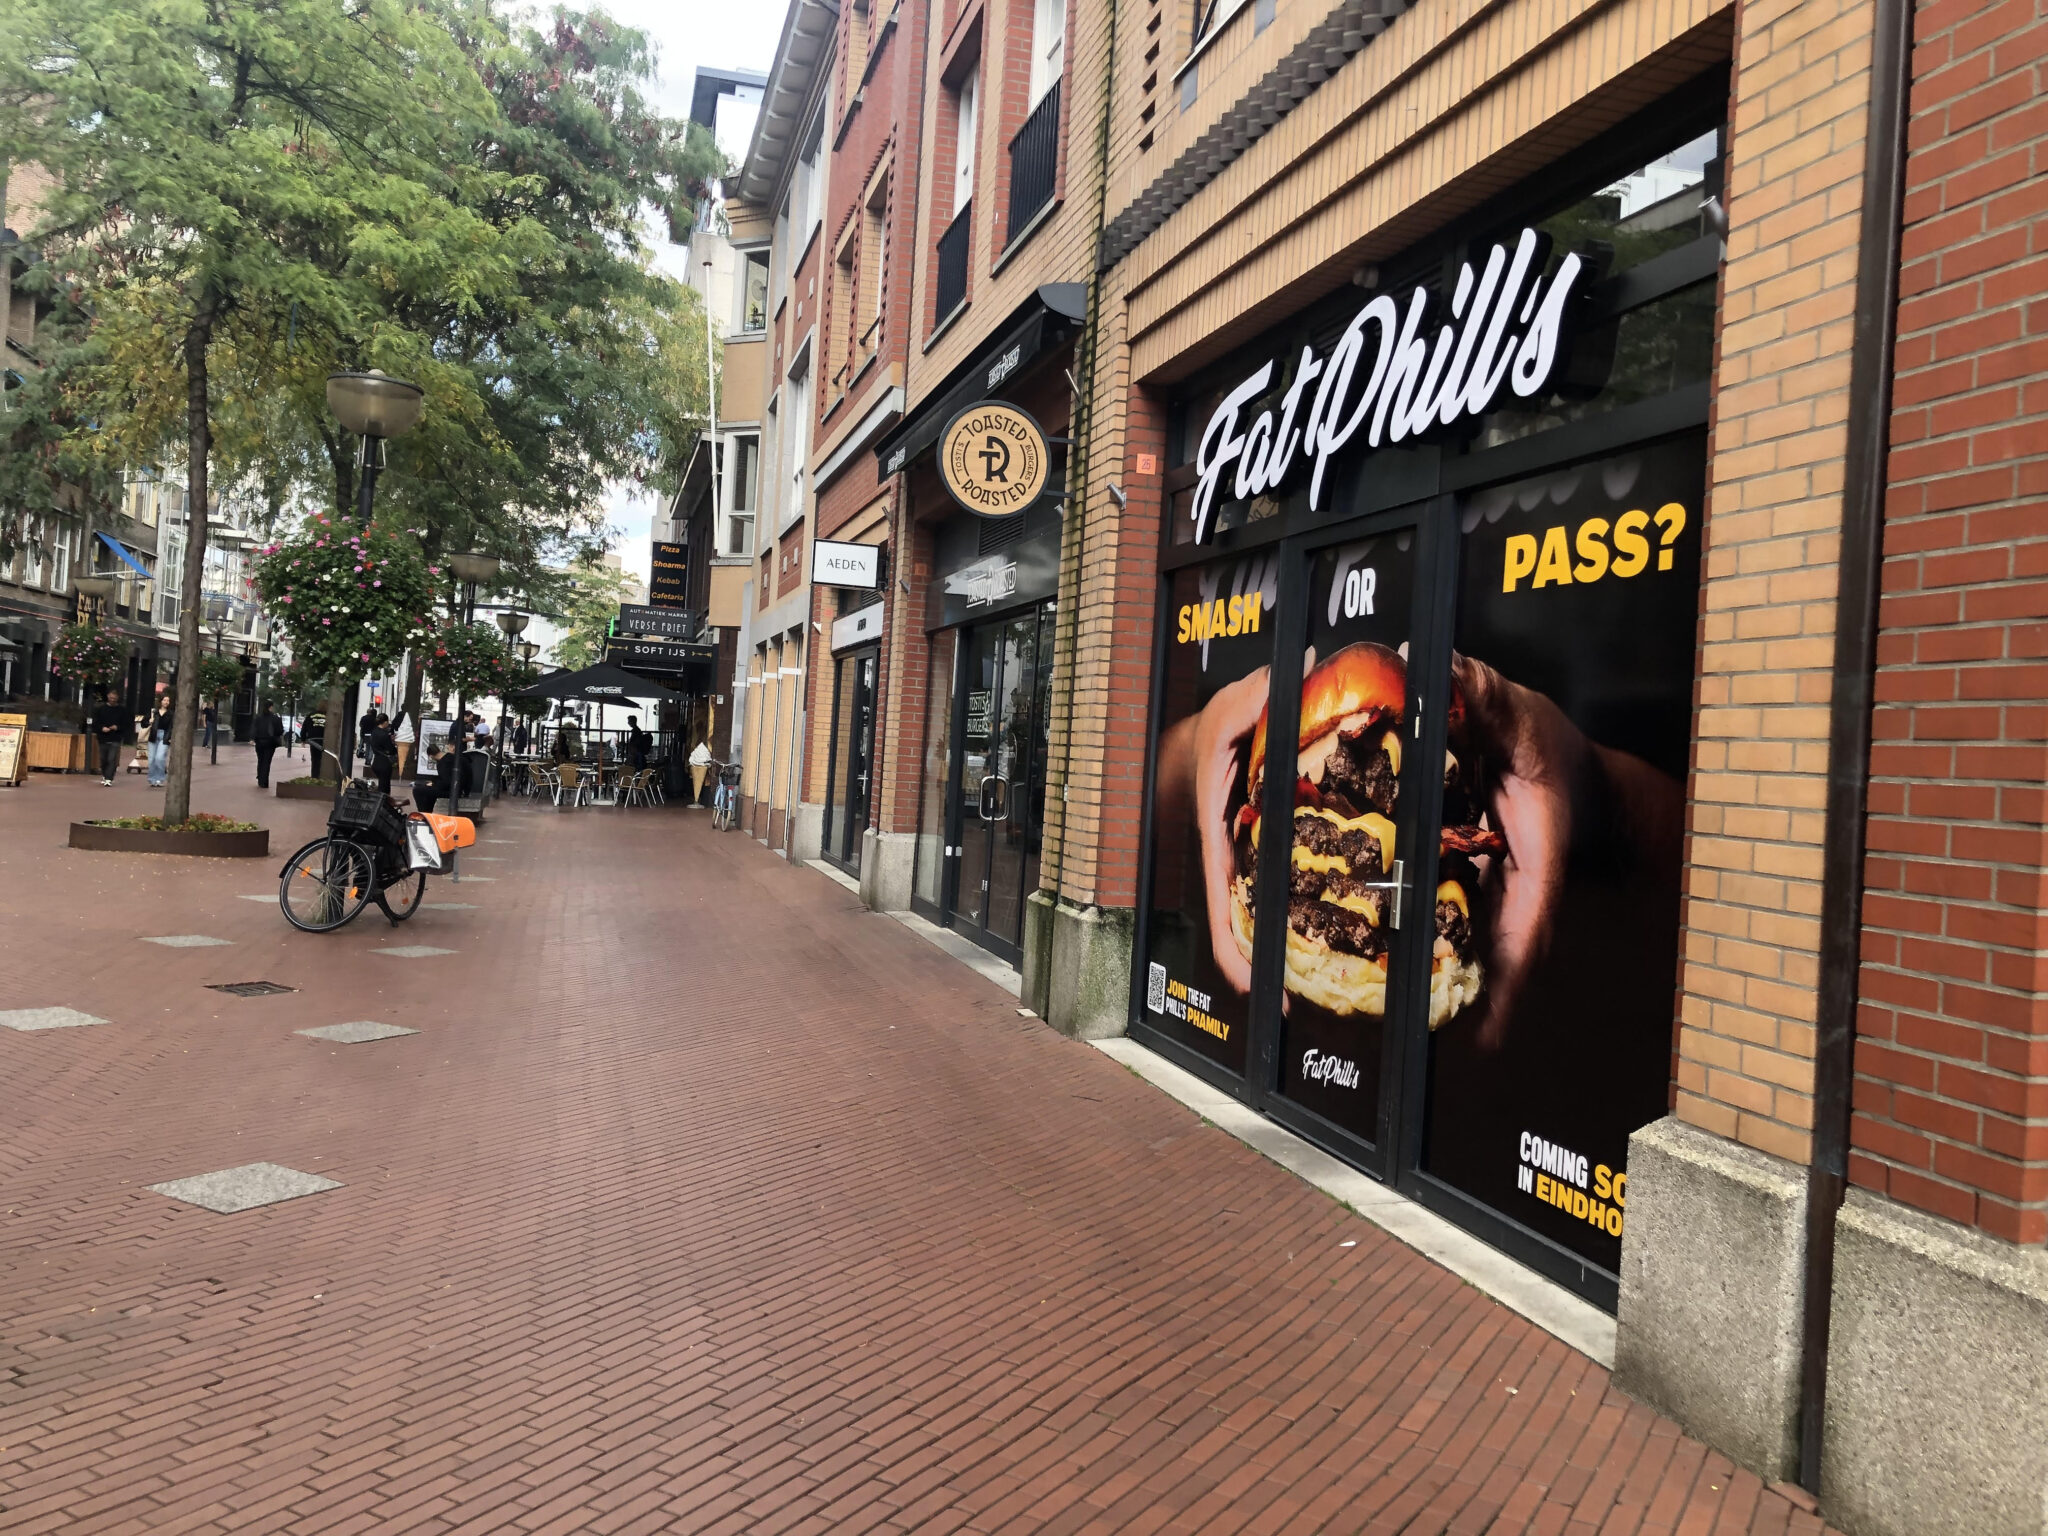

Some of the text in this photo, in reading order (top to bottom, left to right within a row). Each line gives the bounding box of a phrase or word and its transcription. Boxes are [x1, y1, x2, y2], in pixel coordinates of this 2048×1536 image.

[962, 414, 1027, 441] TOASTED
[955, 441, 965, 473] TOSTI'S
[1024, 444, 1035, 481] BURGERS
[961, 478, 1027, 507] ROASTED
[660, 544, 680, 554] Pizza
[1502, 502, 1687, 595] PASS?
[652, 560, 686, 570] Shoarma
[825, 557, 867, 572] AEDEN
[656, 576, 681, 585] Kebab
[1344, 567, 1376, 620] OR
[651, 591, 684, 601] Cafetaria
[629, 619, 687, 634] VERSE FRIET
[1176, 591, 1262, 645] SMASH
[634, 645, 686, 658] SOFT IJS
[1166, 978, 1212, 1012] JOIN THE FAT
[1164, 996, 1230, 1042] PHILL'S PHAMILY
[1519, 1130, 1628, 1208] COMING SO
[1517, 1164, 1624, 1237] IN EINDHO
